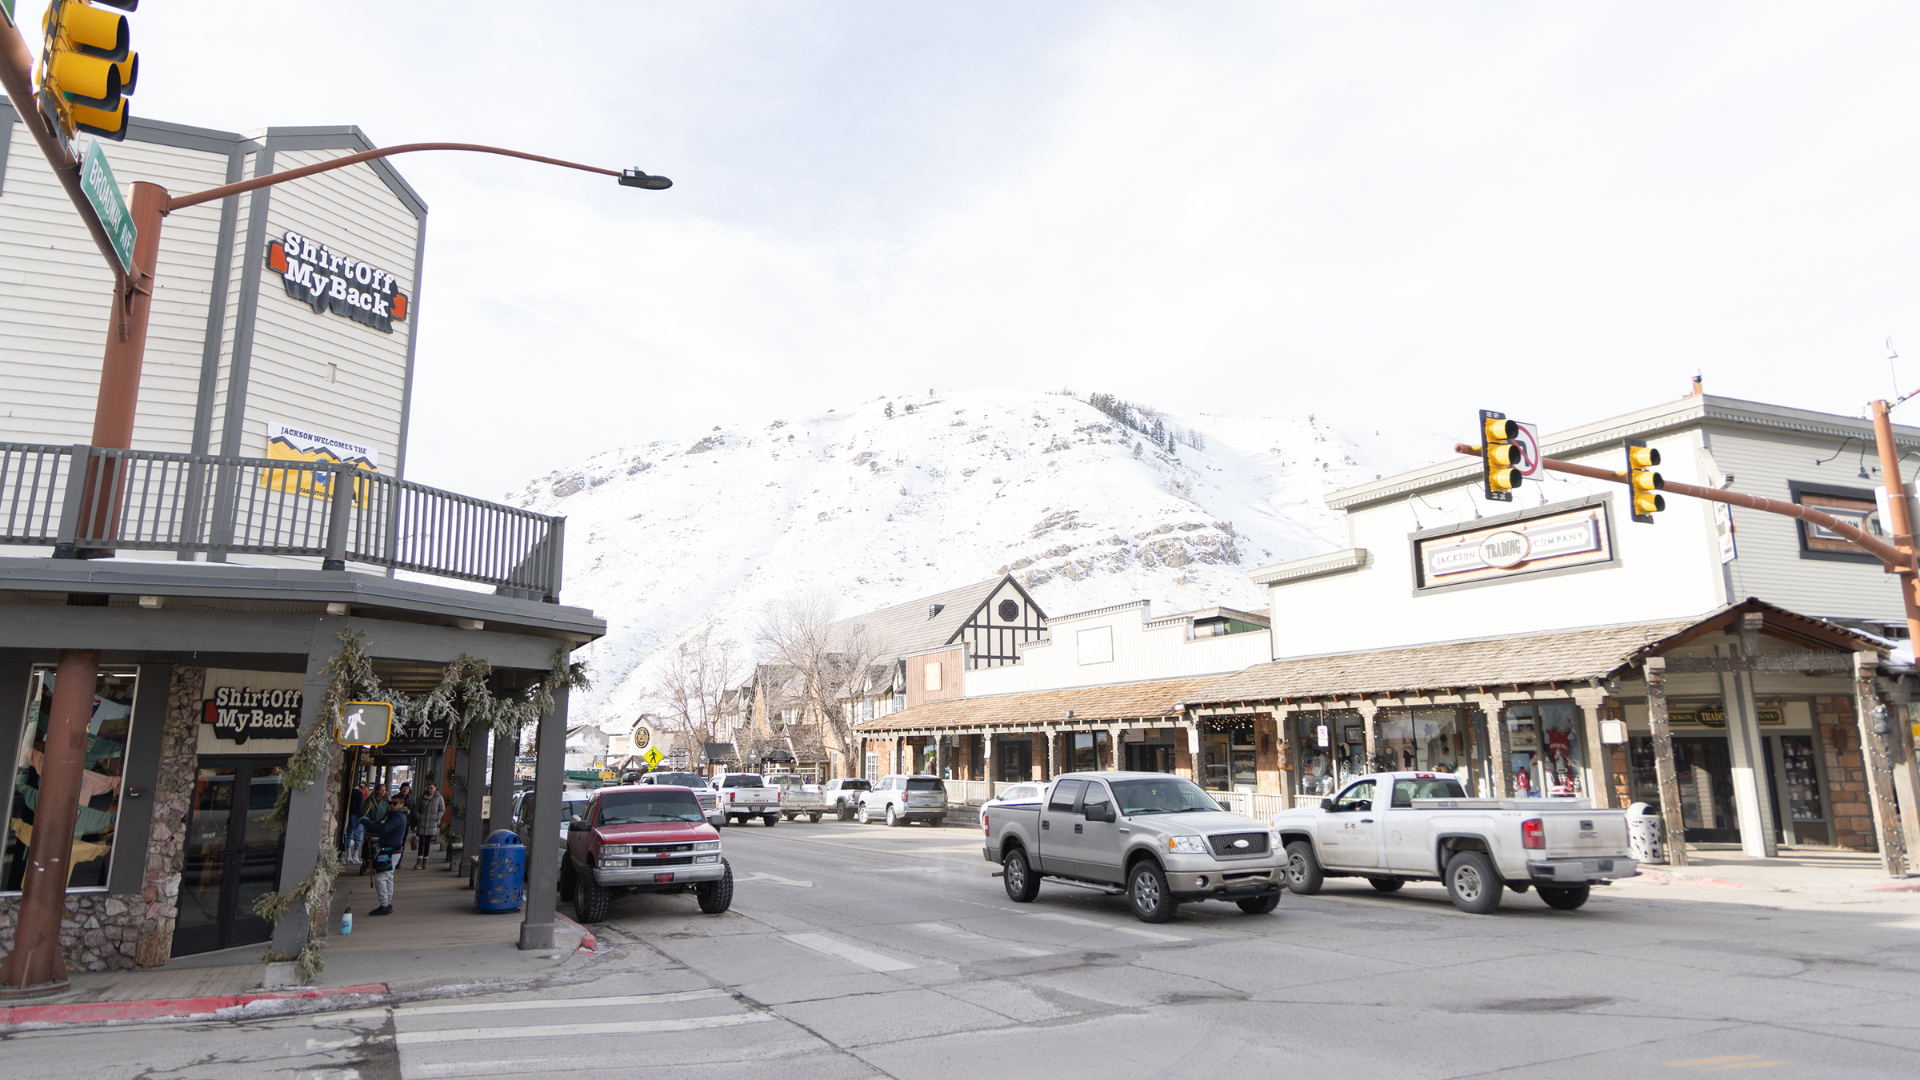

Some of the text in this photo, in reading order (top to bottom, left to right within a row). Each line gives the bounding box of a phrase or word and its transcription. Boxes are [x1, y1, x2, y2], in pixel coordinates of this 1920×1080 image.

[89, 157, 132, 258] BROADWAY AVE
[284, 231, 395, 294] ShirtOff
[284, 257, 389, 318] MyBack
[281, 427, 367, 455] JACKSON WELCOMES THE
[1437, 531, 1585, 566] JACKSON TRADING COMPANY
[216, 687, 301, 708] ShirtOff
[216, 709, 296, 733] MyBack
